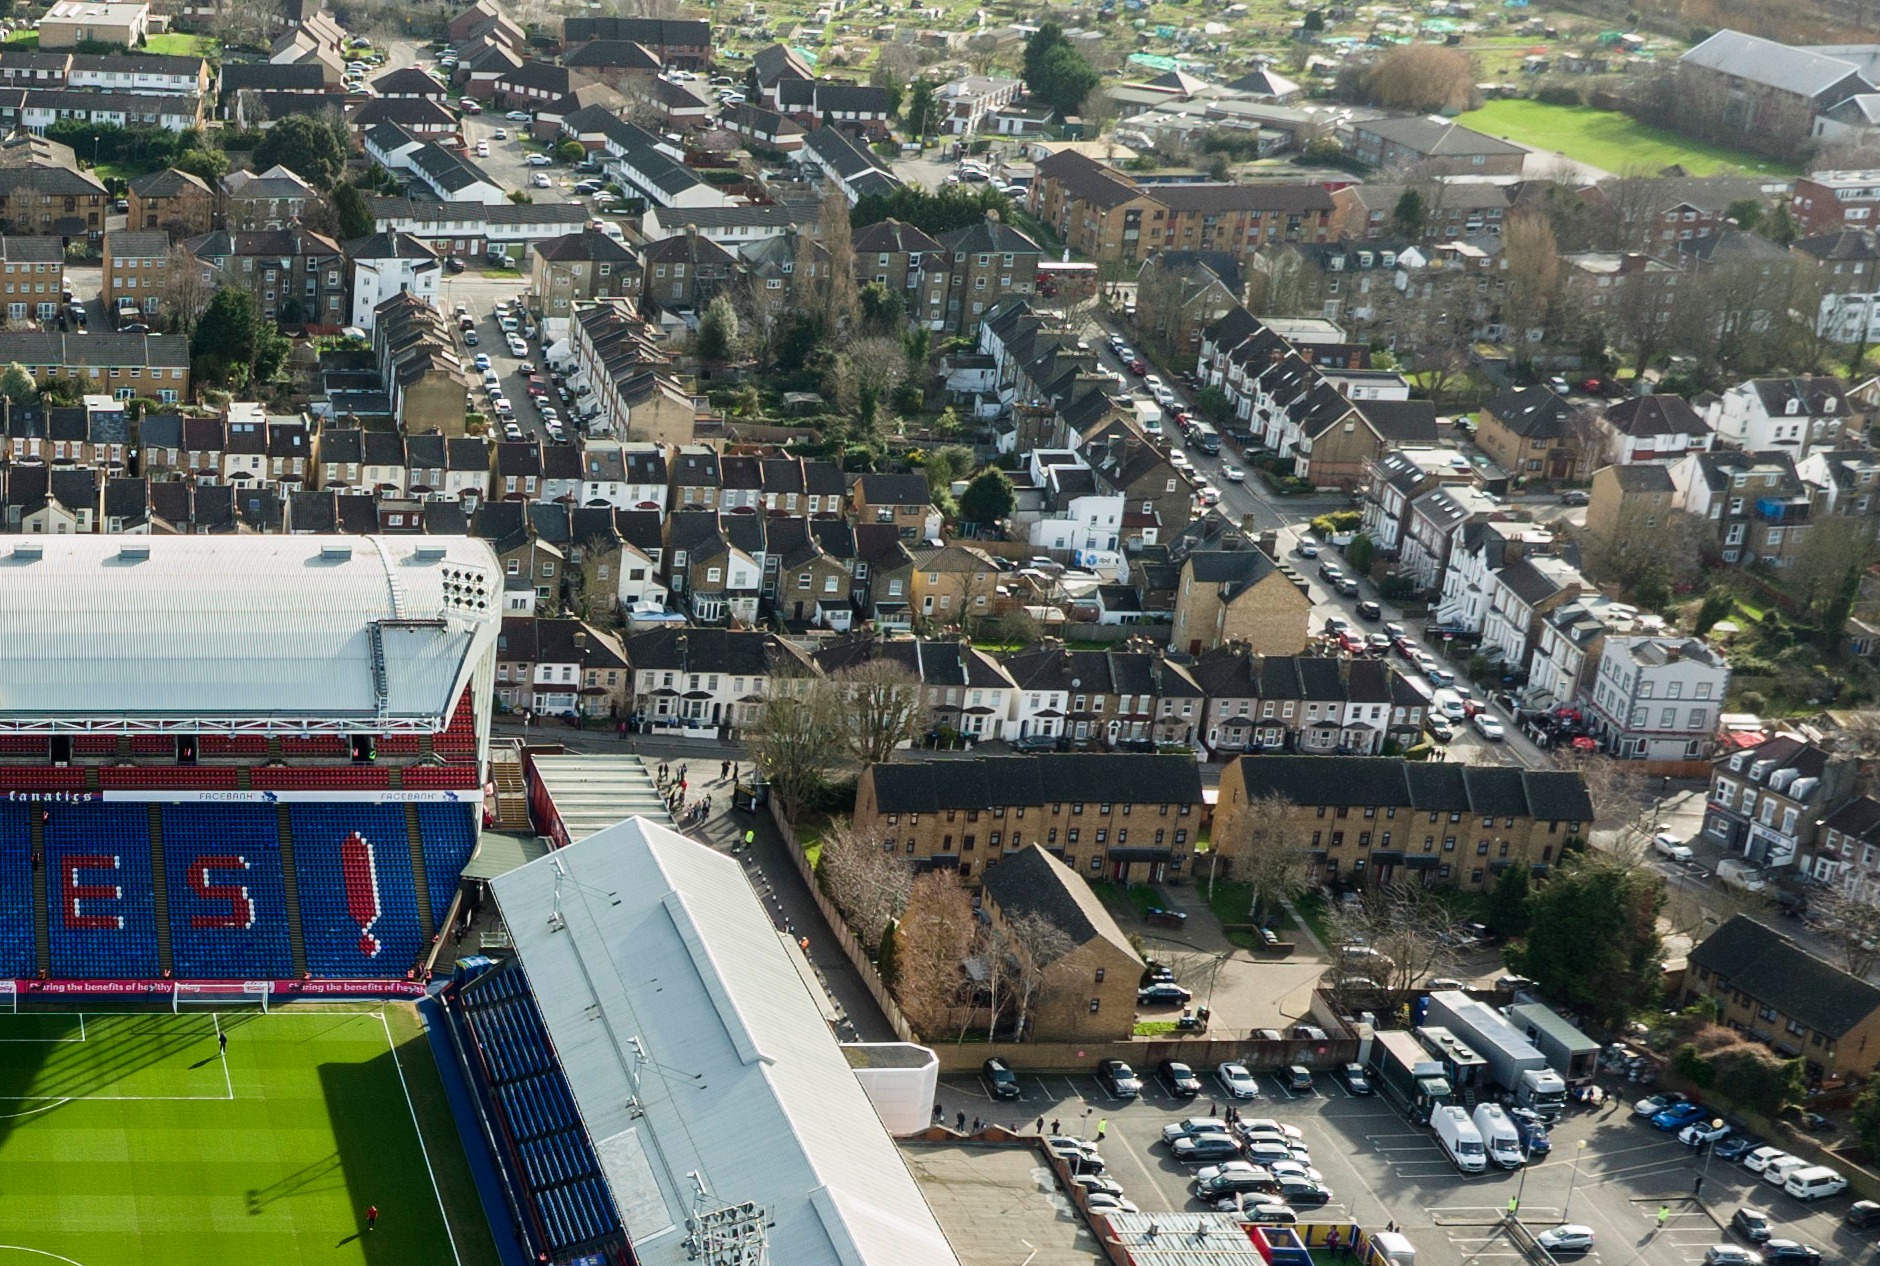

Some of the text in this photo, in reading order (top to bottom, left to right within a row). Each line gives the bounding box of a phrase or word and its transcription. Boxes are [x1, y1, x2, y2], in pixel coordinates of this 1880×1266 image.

[9, 791, 92, 802] fanatics
[199, 792, 253, 800] FACEBANK
[380, 793, 435, 801] FACEBANK
[67, 983, 83, 991] the
[85, 983, 123, 991] benefits
[125, 983, 136, 991] of
[138, 983, 173, 993] helthy
[326, 983, 342, 991] the
[385, 983, 396, 991] of
